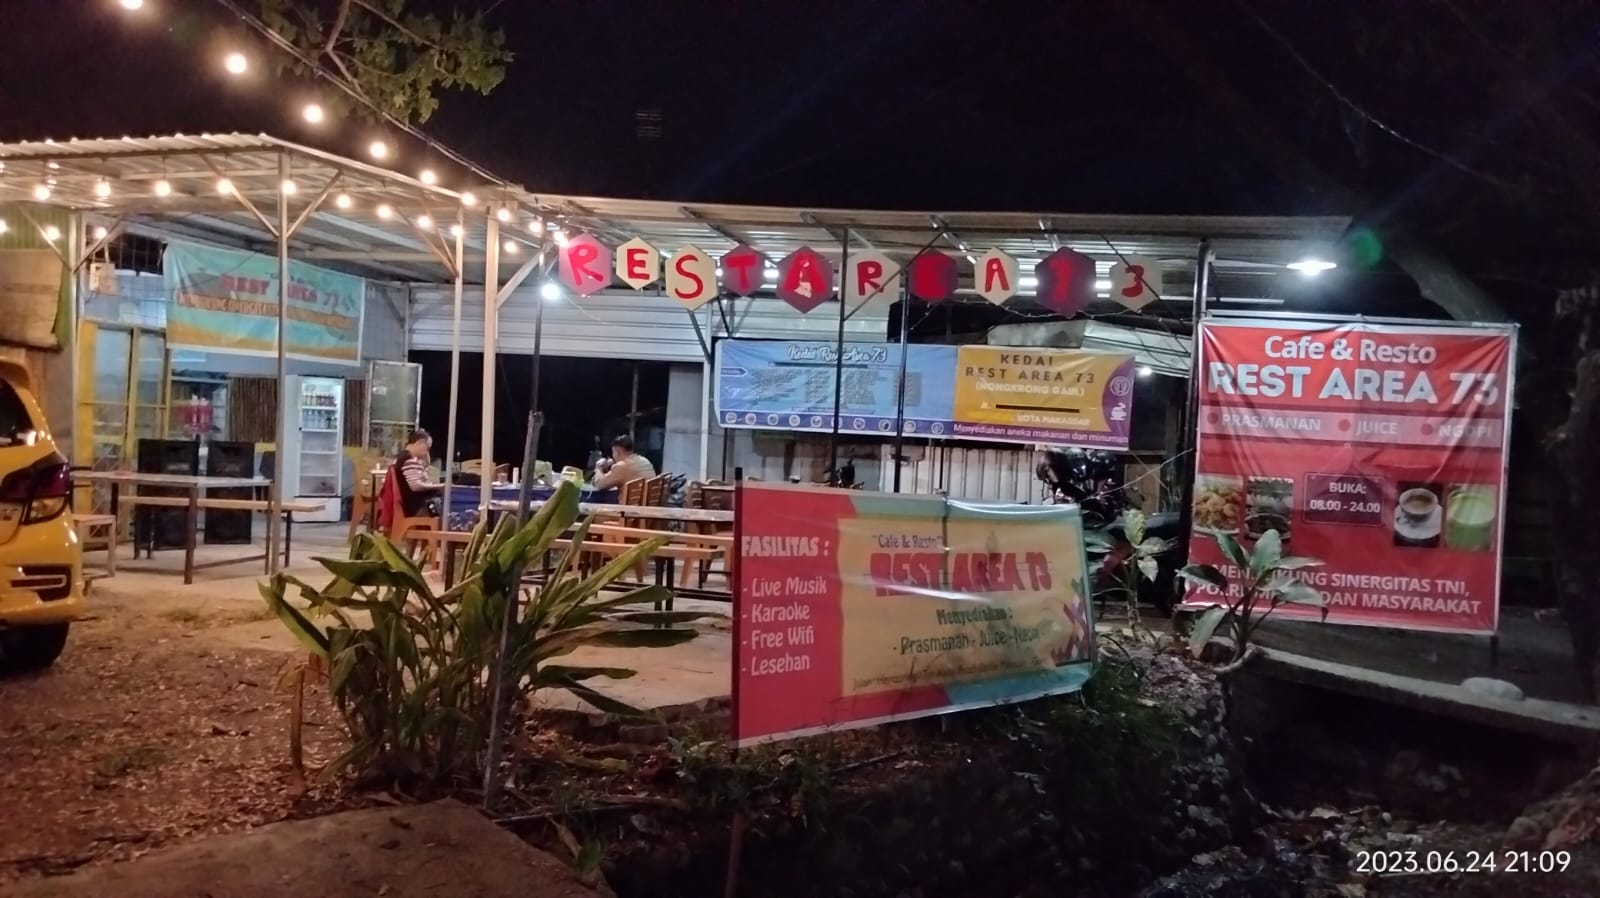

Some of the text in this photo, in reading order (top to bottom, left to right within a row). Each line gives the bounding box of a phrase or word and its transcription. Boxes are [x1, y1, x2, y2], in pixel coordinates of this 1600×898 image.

[568, 243, 757, 299] REST
[871, 346, 888, 362] 73
[1000, 354, 1053, 367] KEDAI
[1264, 335, 1437, 364] Cafe & Resto
[1018, 370, 1064, 382] AREA
[1076, 372, 1095, 384] 73
[1207, 362, 1498, 406] REST AREA 73
[953, 424, 1128, 442] Menyediakan aneka makanan dan minuman
[1222, 414, 1492, 439] PRASMANAN JUICE NGOPI
[1329, 482, 1367, 494] BUKA:
[1310, 499, 1341, 512] 08.00
[1350, 500, 1381, 513] 24.00
[741, 536, 819, 558] FASILITAS
[870, 551, 1052, 597] REST AREA 73
[1331, 573, 1431, 593] SINERGITAS
[1435, 579, 1470, 597] TNI,
[751, 577, 783, 597] Live
[786, 576, 828, 596] Musik
[751, 603, 811, 622] Karaoke
[1320, 591, 1358, 607] DAN
[1362, 593, 1481, 615] MASYARAKAT
[751, 629, 784, 649] Free
[787, 626, 815, 646] Wifi
[900, 633, 969, 655] Prasmanan
[751, 653, 811, 676] Lesehan
